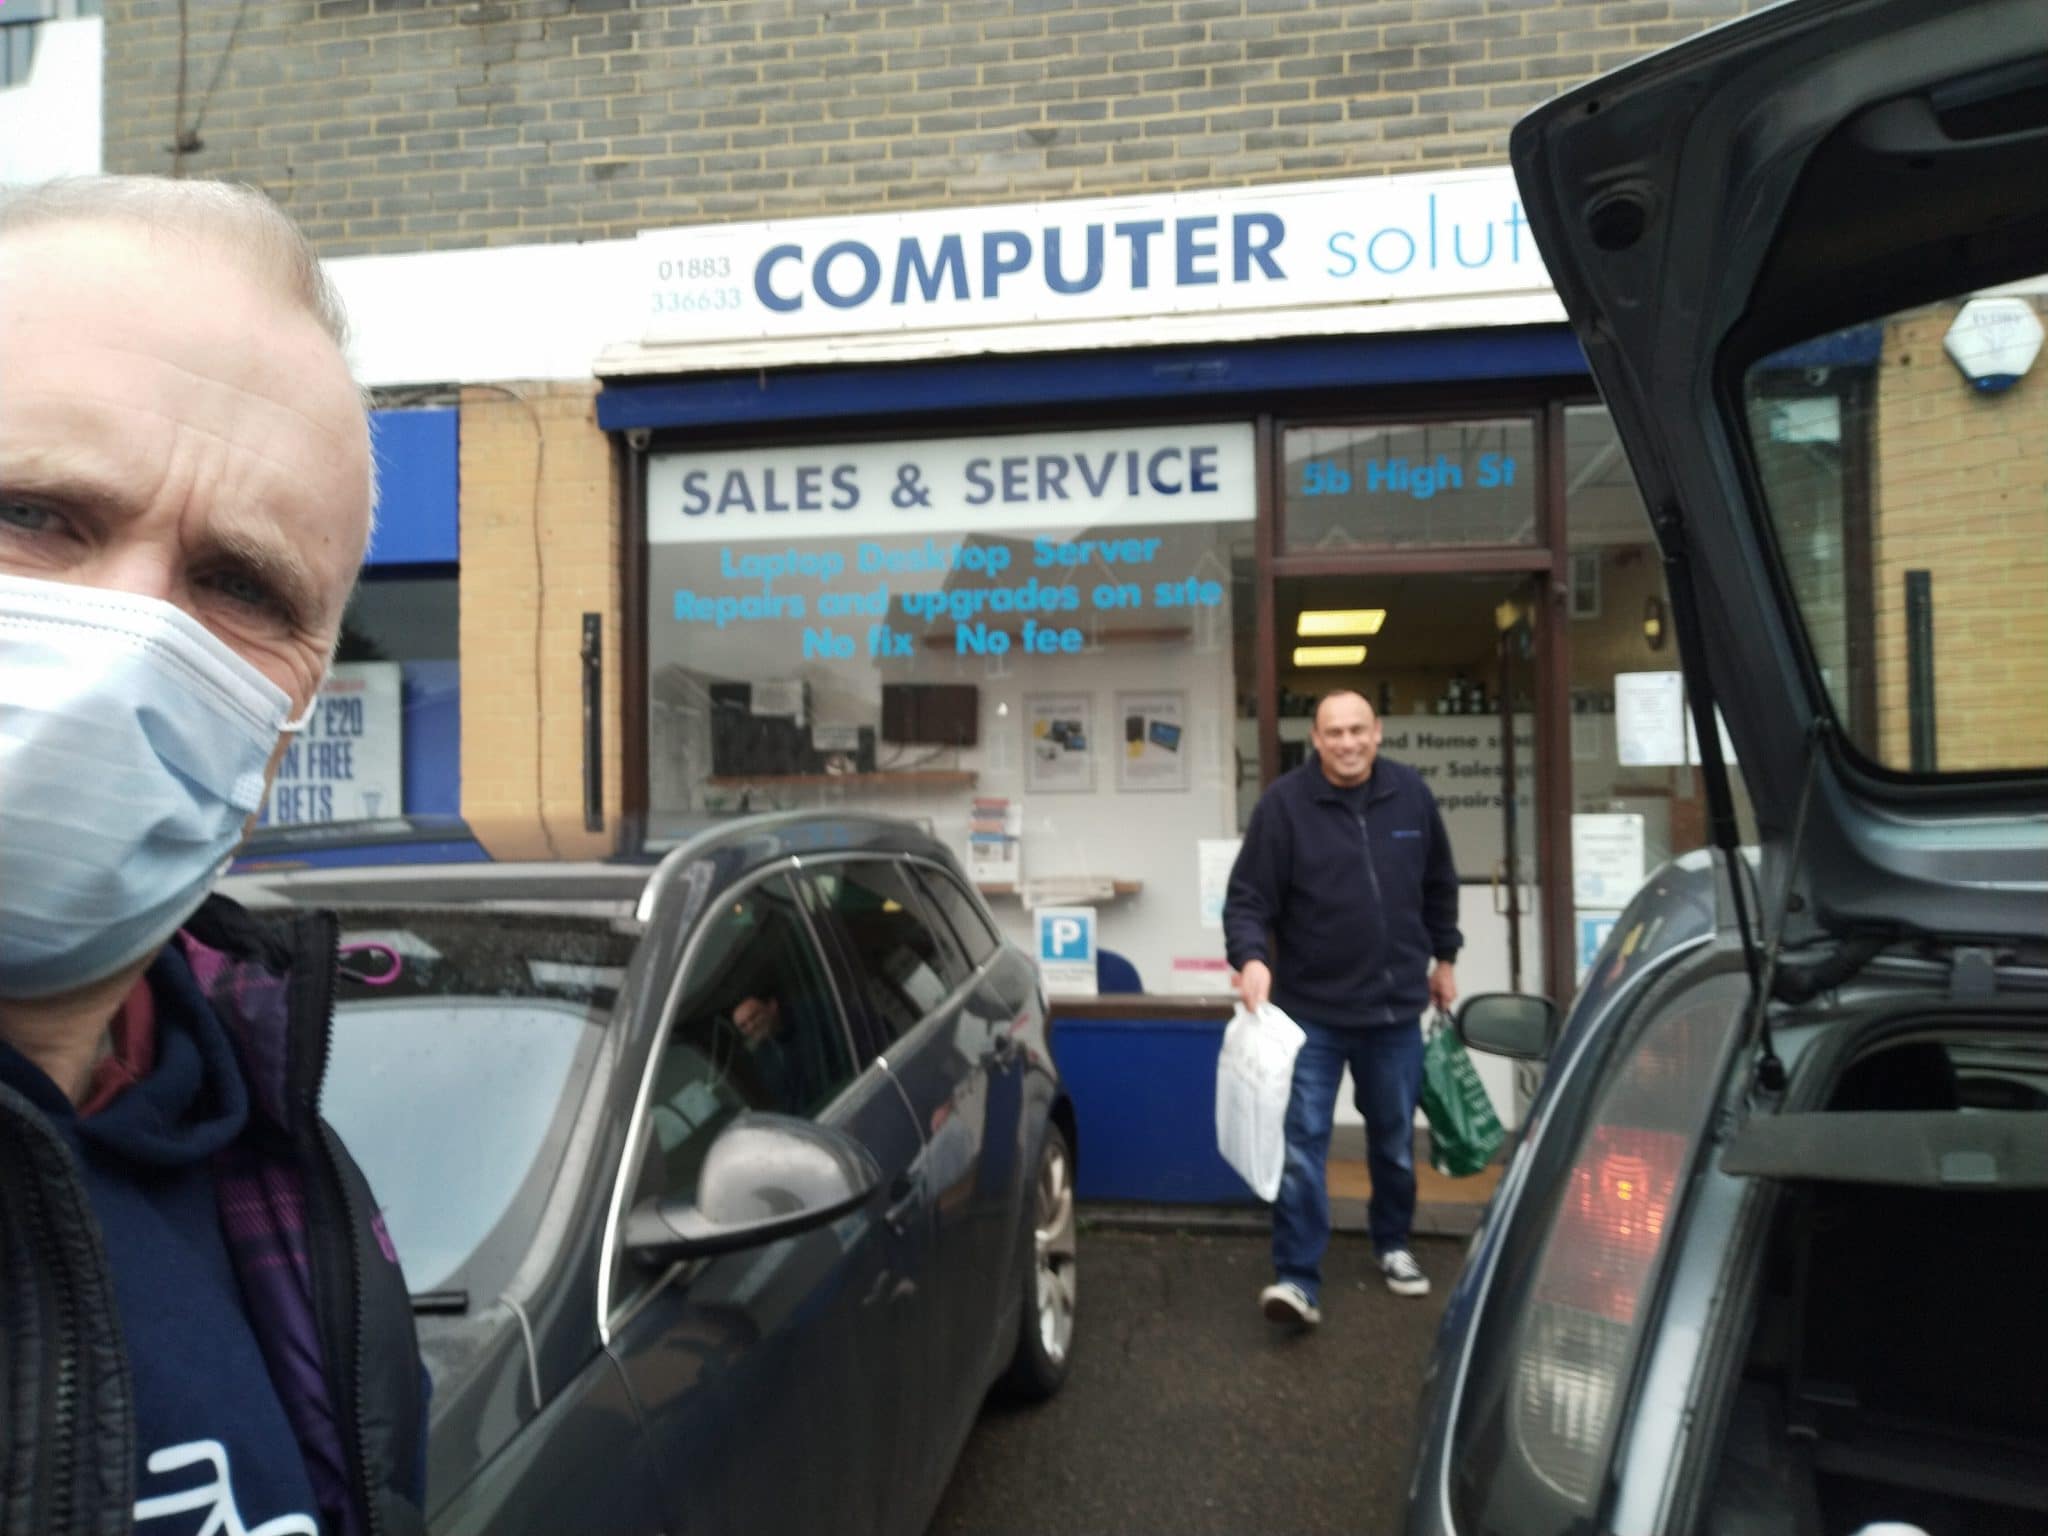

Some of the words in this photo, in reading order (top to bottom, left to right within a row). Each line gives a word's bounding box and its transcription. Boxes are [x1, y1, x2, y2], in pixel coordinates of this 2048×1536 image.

[657, 255, 731, 281] 01883
[753, 211, 1288, 313] COMPUTER
[651, 286, 742, 314] 336633
[681, 463, 861, 517] SALES
[890, 462, 932, 509] &
[963, 445, 1220, 506] SERVICE
[1301, 458, 1352, 497] 5b
[1366, 455, 1464, 500] High
[1477, 452, 1517, 489] St
[720, 546, 846, 584] Laptop
[856, 537, 1011, 579] Desktop
[1032, 534, 1162, 569] Server
[673, 588, 807, 630] Repairs
[817, 580, 889, 618] and
[901, 576, 1081, 624] upgrades
[1092, 582, 1143, 609] on
[1154, 575, 1223, 608] site
[801, 625, 857, 661] No
[867, 623, 915, 658] fix
[955, 620, 1011, 656] No
[1021, 617, 1084, 655] fee
[1416, 732, 1480, 748] Home
[307, 741, 354, 780] FREE
[277, 785, 333, 824] BETS
[1437, 793, 1505, 811] epairs
[1052, 918, 1082, 956] P
